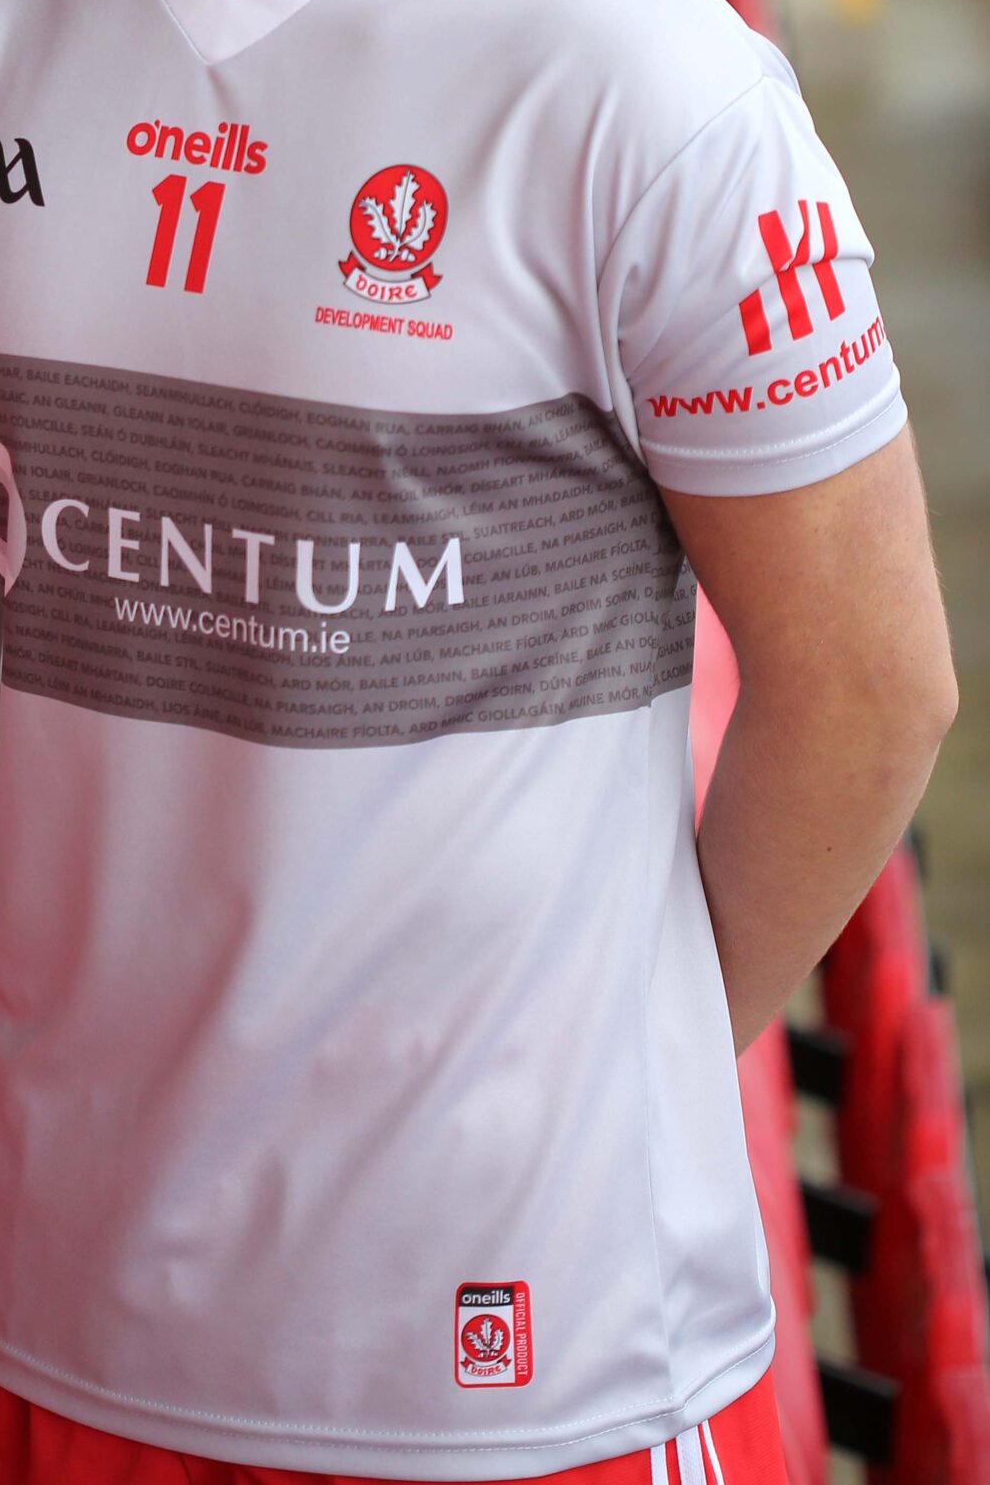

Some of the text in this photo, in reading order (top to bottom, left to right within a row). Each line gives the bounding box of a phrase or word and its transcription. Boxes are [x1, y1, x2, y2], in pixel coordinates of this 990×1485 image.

[126, 119, 268, 175] o'neills
[146, 173, 226, 294] 11
[315, 306, 454, 341] DEVELOPMENT SQUAD
[26, 369, 479, 436] BAILE EACHAIDH, SEANMHULLACH, EOGHAN CARRAIG
[11, 415, 490, 480] COLMCILLE, SEÁN Ó SLEACHT SLEACHT NAOMH
[32, 395, 51, 408] AN
[113, 405, 163, 424] GLEANN
[167, 414, 185, 427] AN
[395, 443, 408, 458] Ó
[31, 466, 594, 526] IOLAIR, GRIANLOCH, Ó CILL RIA, LÉIM AN MHADAIDH,
[155, 460, 207, 480] EOGHAN
[241, 474, 297, 494] CARRAIG
[300, 484, 345, 500] BHÁN,
[351, 490, 373, 501] AN
[471, 474, 526, 494] DÍSEART
[464, 522, 627, 565] COLMCILLE, NA PIARSAIGH,
[474, 510, 585, 539] SUAITREACH, ARD
[41, 498, 466, 615] CENTUM
[491, 537, 652, 581] AN LÚB, MACHAIRE FÍOLTA,
[494, 572, 609, 605] IARAINN, BAILE NA
[114, 595, 352, 654] www.centum.ie
[381, 599, 602, 642] NA PIARSAIGH, AN DROIM, DROIM
[136, 650, 173, 666] BAILE
[281, 678, 312, 691] ARD
[316, 677, 355, 692] MÓR,
[359, 677, 399, 692] BAILE
[403, 670, 467, 687] IARAINN,
[471, 665, 508, 680] BAILE
[533, 650, 583, 670] SCRÍNE,
[615, 637, 635, 652] AN
[300, 655, 332, 667] LIOS
[336, 652, 375, 668] ÁINE,
[380, 653, 402, 665] AN
[406, 651, 435, 666] LÚB,
[439, 640, 512, 660] MACHAIRE
[516, 630, 558, 651] FÍOLTA,
[561, 626, 589, 640] ARD
[146, 675, 572, 716] DOIRE PIARSAIGH, AN DROIM, DÚN
[271, 723, 349, 740] MACHAIRE
[353, 723, 405, 738] FÍOLTA,
[409, 720, 439, 734] ARD
[515, 1292, 526, 1331] OFFICIAL
[516, 1333, 528, 1376] PRODUCT
